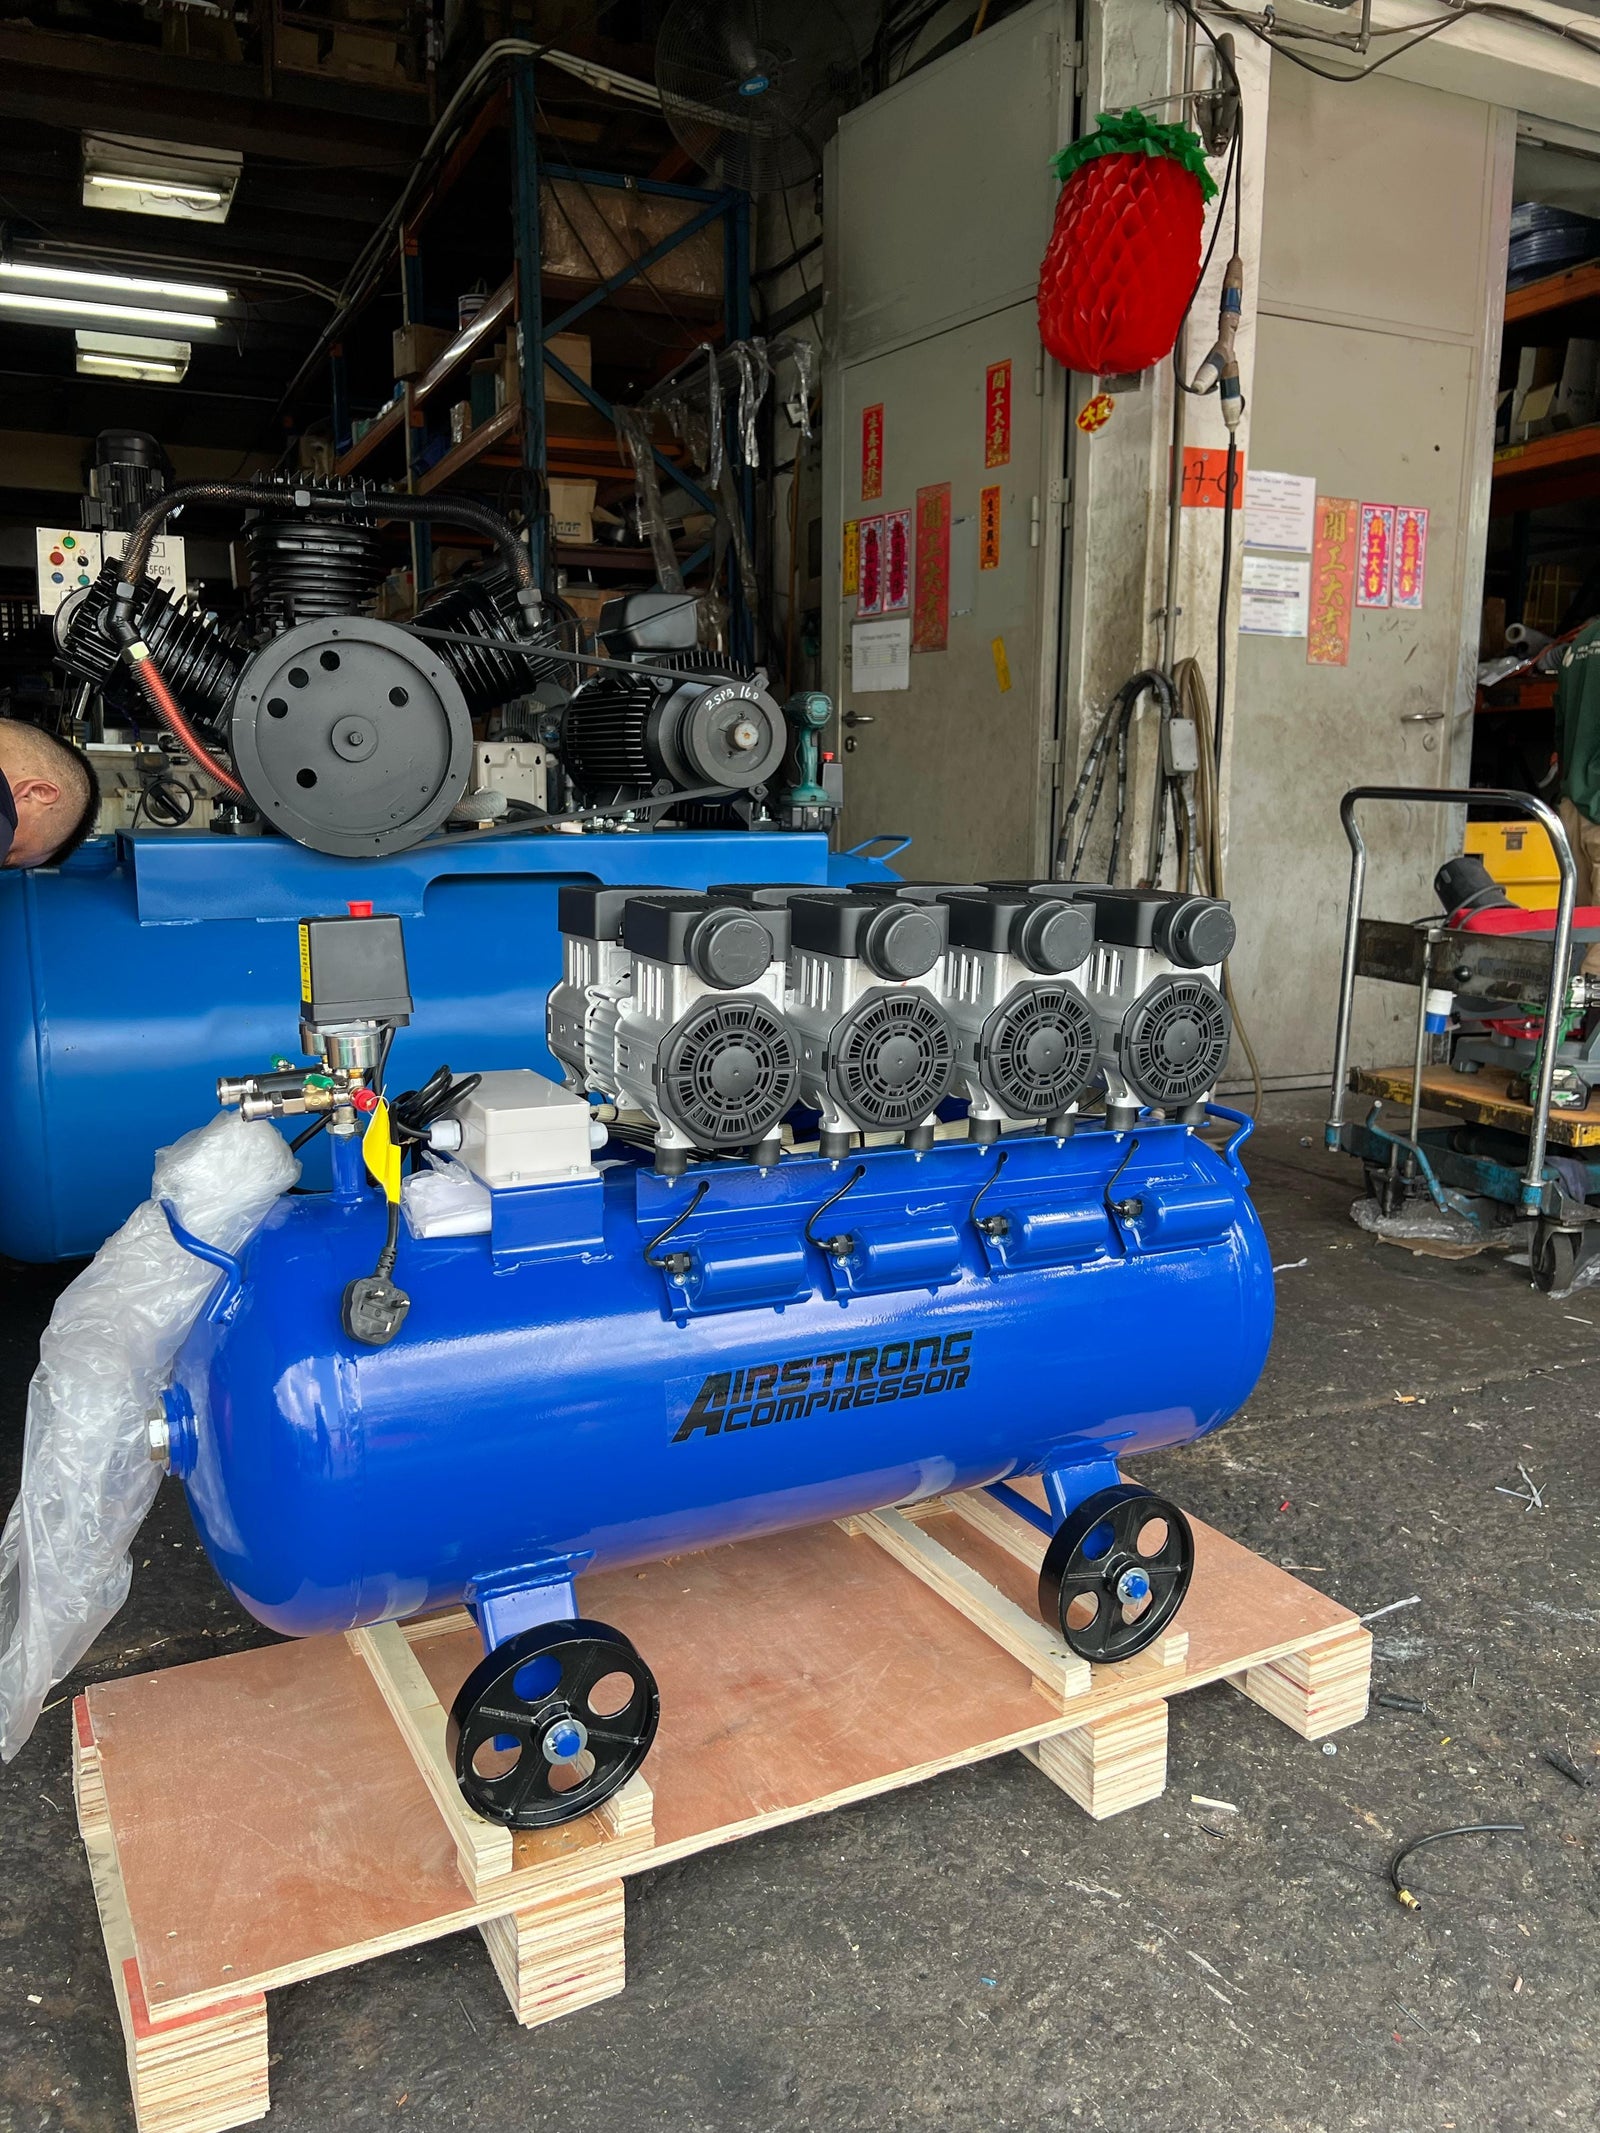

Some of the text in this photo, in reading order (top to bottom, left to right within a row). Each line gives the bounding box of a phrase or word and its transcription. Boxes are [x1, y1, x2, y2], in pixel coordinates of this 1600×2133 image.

[1317, 512, 1346, 636] 開工大吉
[1368, 521, 1384, 593] 開工大吉
[740, 685, 759, 700] 160
[670, 1330, 974, 1444] AIRSTRONG
[723, 1365, 971, 1433] COMPRESSOR
